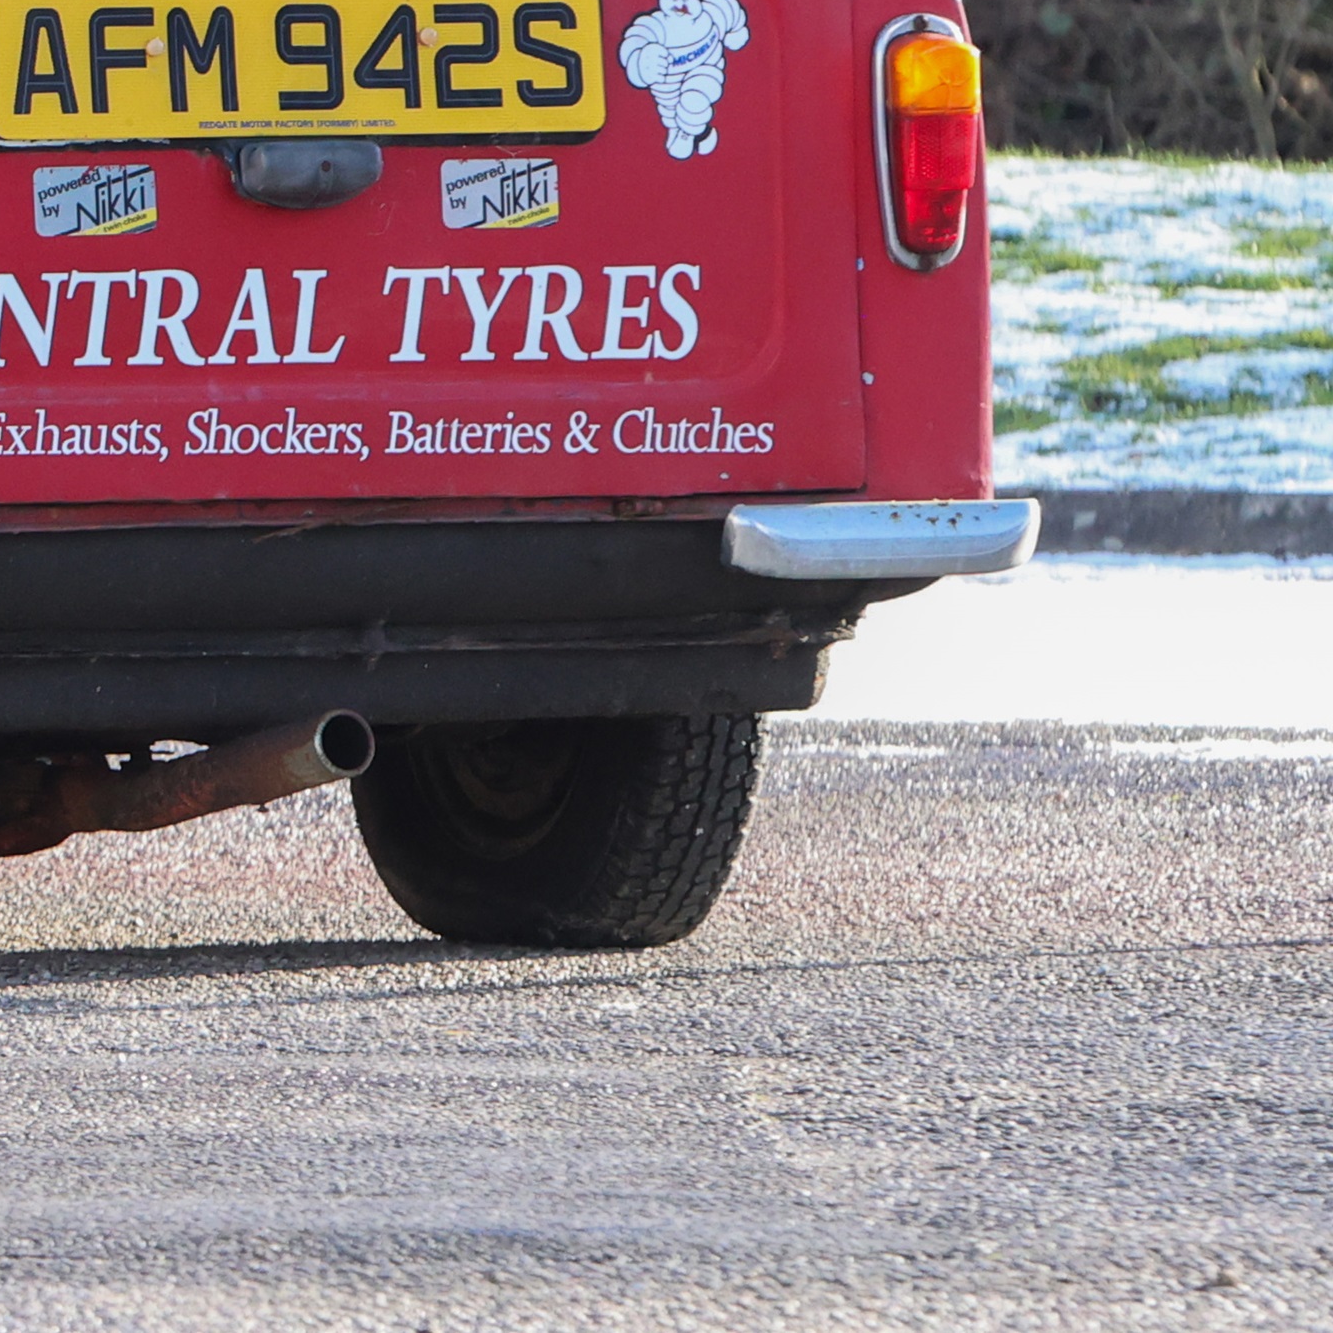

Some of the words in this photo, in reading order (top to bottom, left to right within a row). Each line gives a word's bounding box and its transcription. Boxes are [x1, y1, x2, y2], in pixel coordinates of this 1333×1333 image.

[14, 6, 239, 115] AFM
[275, 2, 585, 111] 942S
[240, 120, 273, 128] MOTOR
[38, 168, 101, 203] powered
[68, 167, 150, 230] Nikki
[445, 161, 506, 195] powered
[475, 162, 552, 222] Nikki
[41, 203, 60, 218] by
[449, 196, 467, 210] by
[382, 263, 701, 362] TYRES
[184, 407, 371, 462] Shockers,
[384, 411, 551, 454] Batteries
[563, 410, 601, 454] &
[612, 407, 774, 454] Clutches
